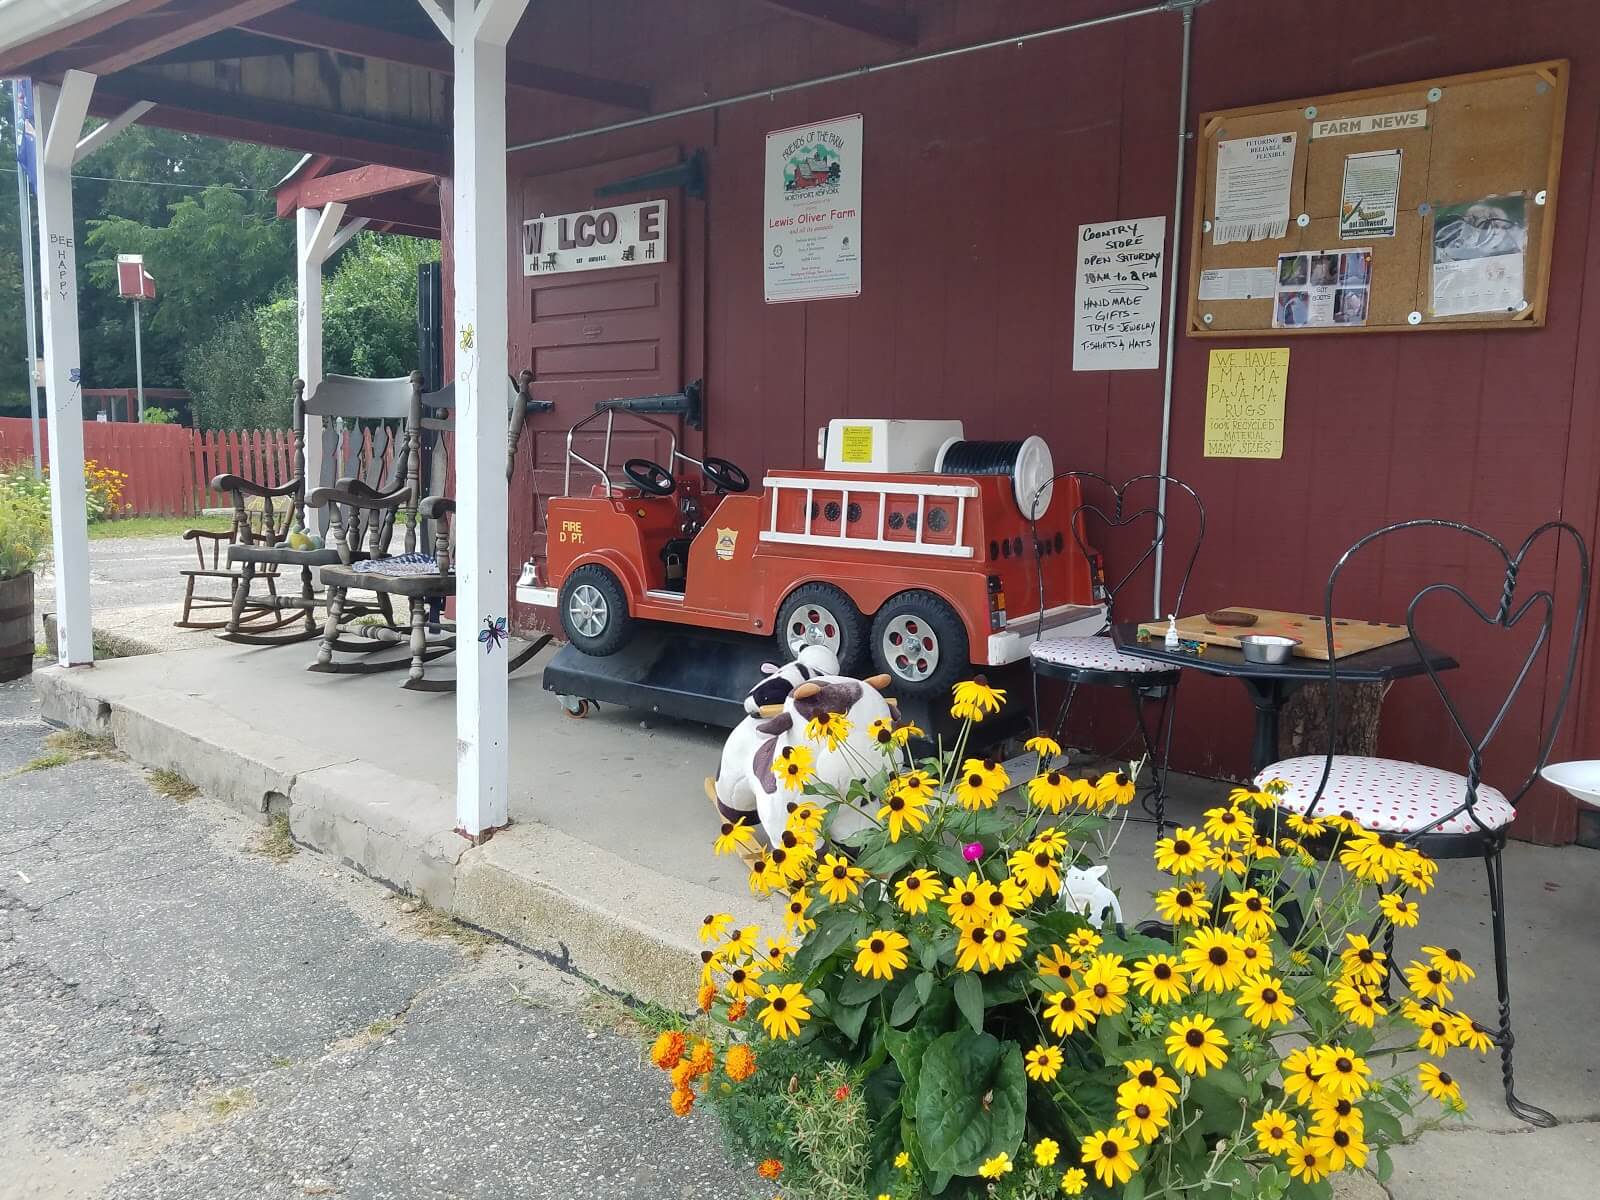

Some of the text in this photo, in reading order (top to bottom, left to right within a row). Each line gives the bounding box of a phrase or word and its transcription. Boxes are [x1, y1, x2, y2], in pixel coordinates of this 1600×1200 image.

[1320, 114, 1418, 135] FARM NEWS
[782, 136, 805, 160] FRIENDS
[806, 131, 815, 143] OF
[817, 131, 828, 143] THE
[1246, 138, 1278, 147] TUTORING
[1250, 144, 1281, 153] RELIABLE
[1256, 151, 1287, 160] FLEXIBLE
[785, 191, 814, 201] NORTHPORT
[769, 208, 856, 229] Lewis Oliver Farm
[50, 233, 73, 248] BEE
[1105, 235, 1144, 250] STORE
[1084, 252, 1160, 268] OPEN SATURDAY
[58, 250, 68, 300] HAPPY
[1095, 311, 1130, 321] GIFTS
[1086, 321, 1156, 335] TOYS JEWELRY
[1081, 340, 1118, 351] T-SHIRTS
[1129, 338, 1152, 350] HATS
[1215, 351, 1277, 366] WE HAVE
[1225, 403, 1267, 418] RUGS
[1232, 420, 1274, 431] RECYCLED
[1224, 431, 1265, 441] MATERIAL
[1208, 442, 1272, 455] MANY SIZES
[562, 520, 582, 533] FIRE
